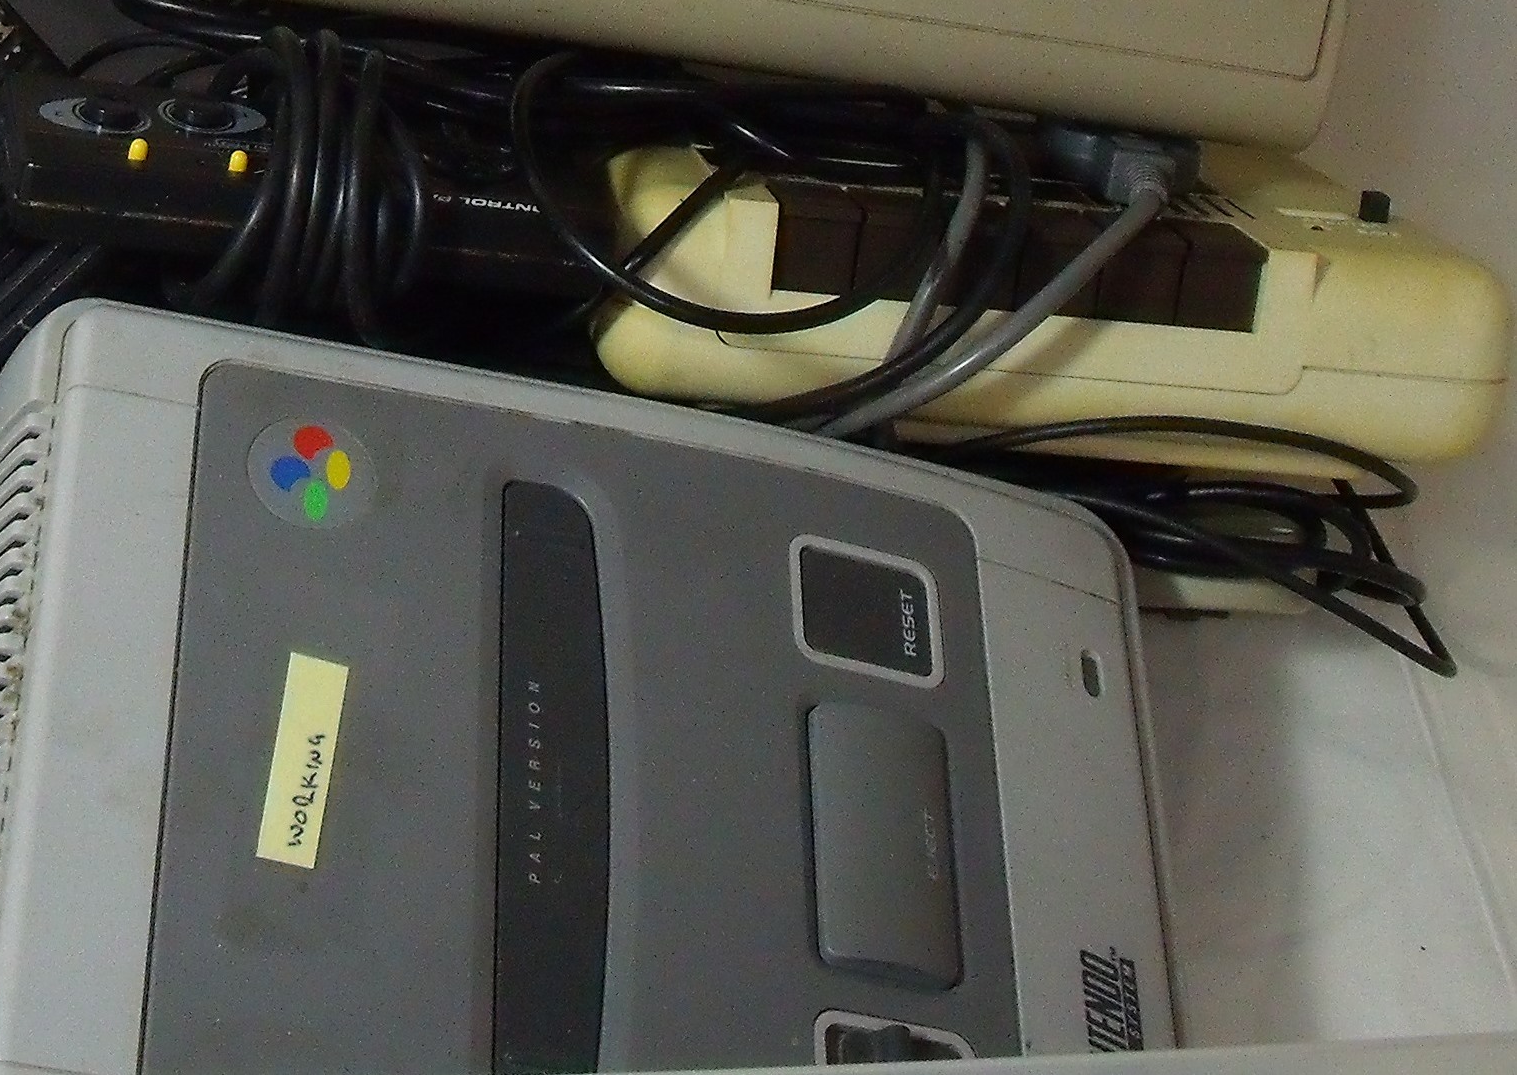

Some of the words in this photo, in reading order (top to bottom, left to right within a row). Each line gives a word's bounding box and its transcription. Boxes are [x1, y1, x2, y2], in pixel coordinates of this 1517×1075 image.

[903, 589, 917, 658] RESET
[287, 733, 326, 847] WORKING
[528, 679, 543, 811] VERSION
[528, 831, 543, 885] PAL
